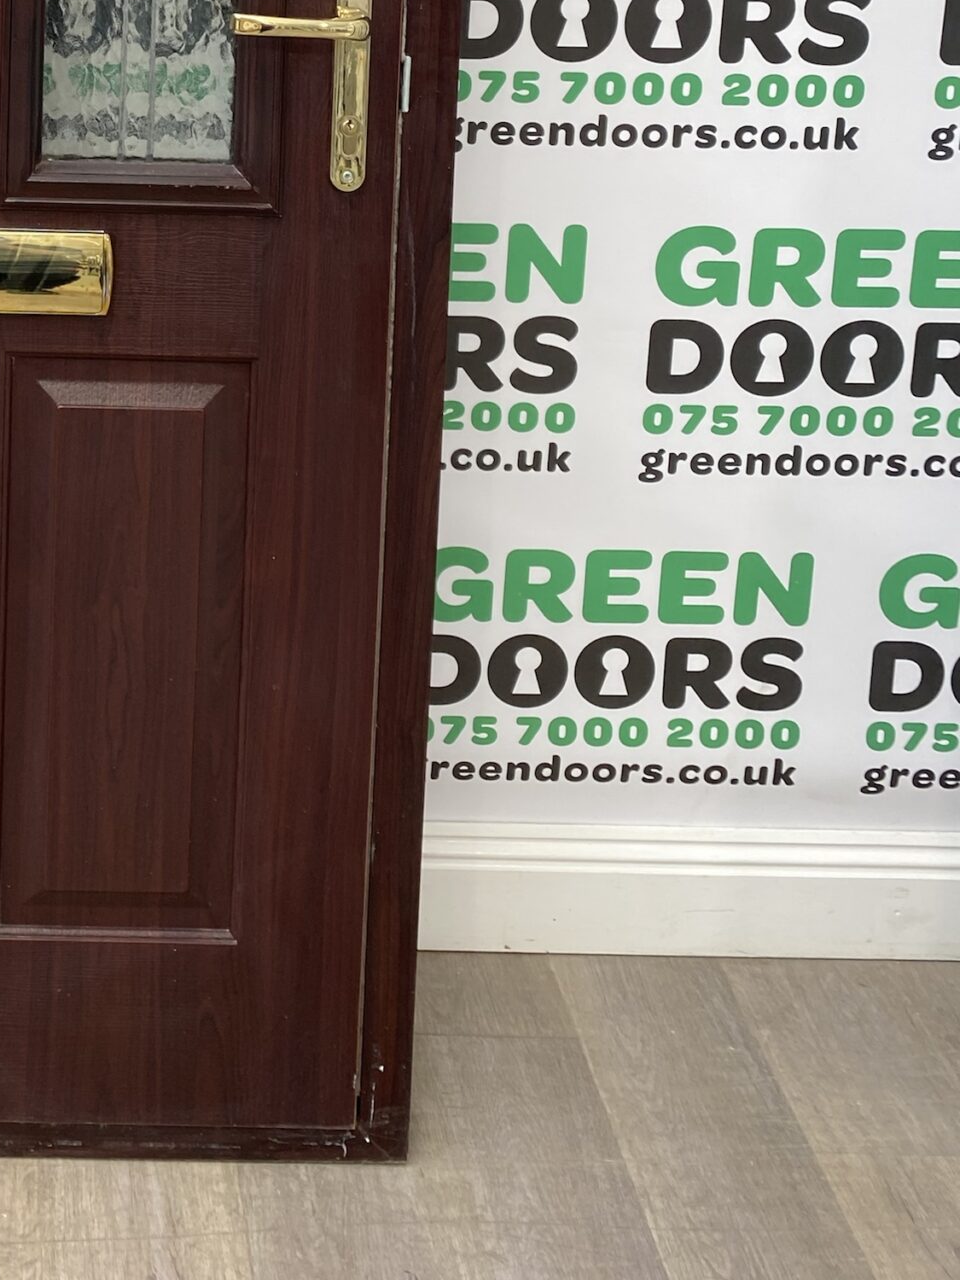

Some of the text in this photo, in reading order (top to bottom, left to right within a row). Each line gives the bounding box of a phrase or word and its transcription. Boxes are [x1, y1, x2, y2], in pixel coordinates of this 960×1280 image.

[561, 70, 703, 106] 7000
[721, 72, 866, 108] 2000
[443, 400, 576, 434] 2000
[642, 403, 738, 437] 075
[757, 404, 894, 438] 7000
[433, 546, 815, 627] GREEN
[428, 633, 803, 711] DOORS
[869, 641, 960, 712] D
[428, 715, 800, 750] 75 7000 2000
[865, 721, 960, 752] 075
